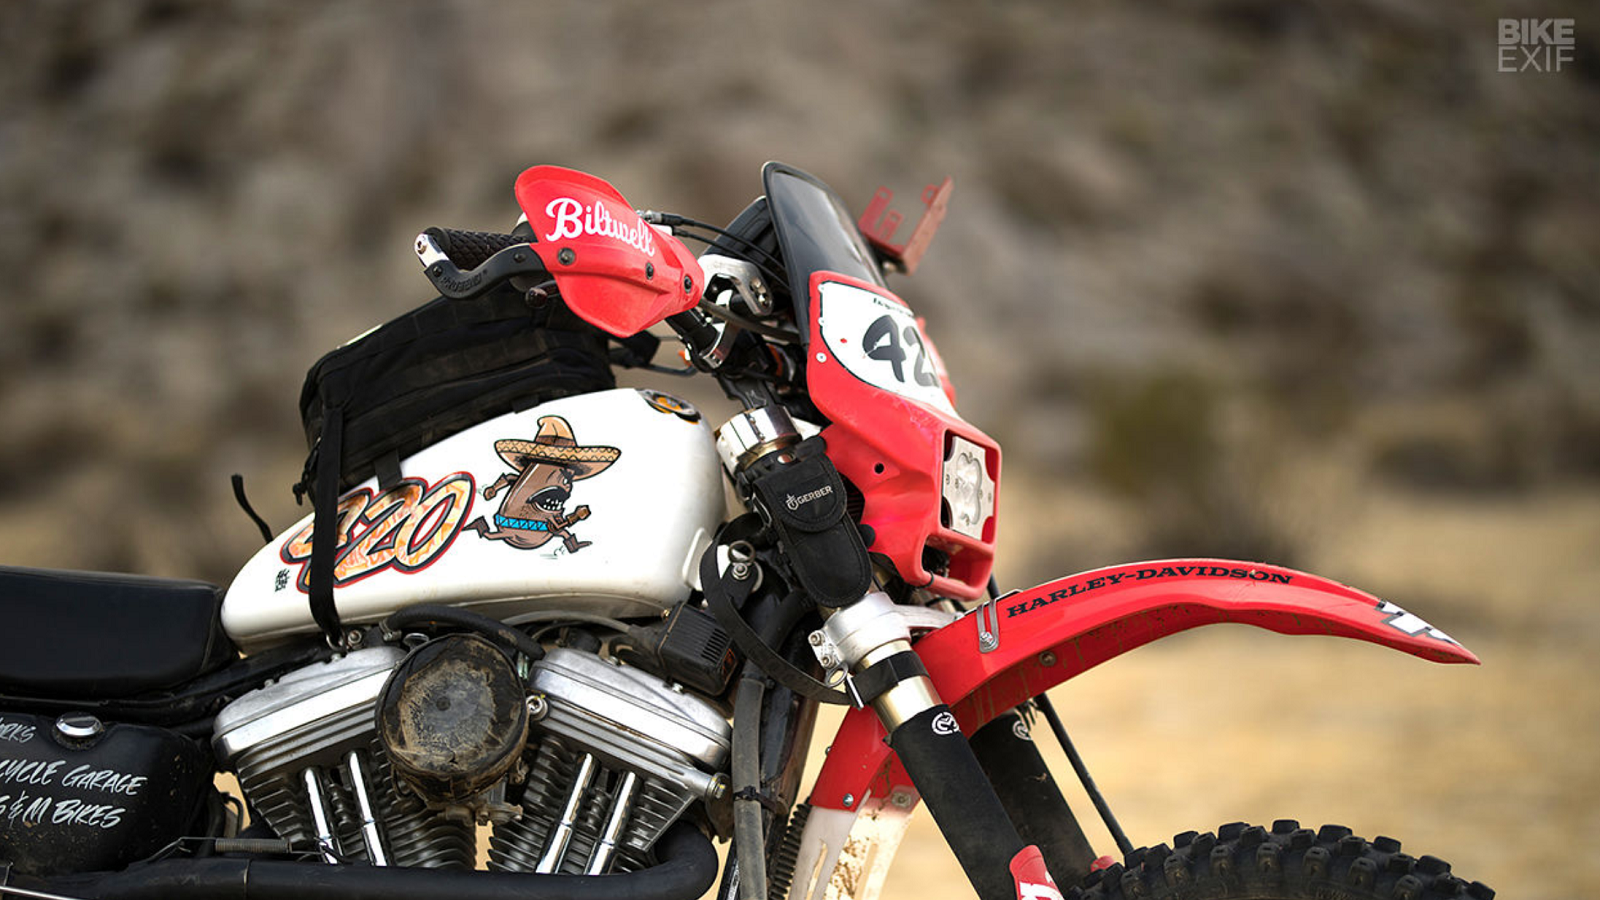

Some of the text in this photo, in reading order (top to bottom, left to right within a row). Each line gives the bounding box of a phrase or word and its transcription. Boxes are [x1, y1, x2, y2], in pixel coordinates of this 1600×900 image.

[545, 197, 655, 257] Biltwell
[798, 485, 833, 504] GERBER
[1006, 566, 1294, 618] HARLEY-DAVIDSON
[61, 764, 148, 796] GARAGE
[52, 799, 126, 829] BIKES
